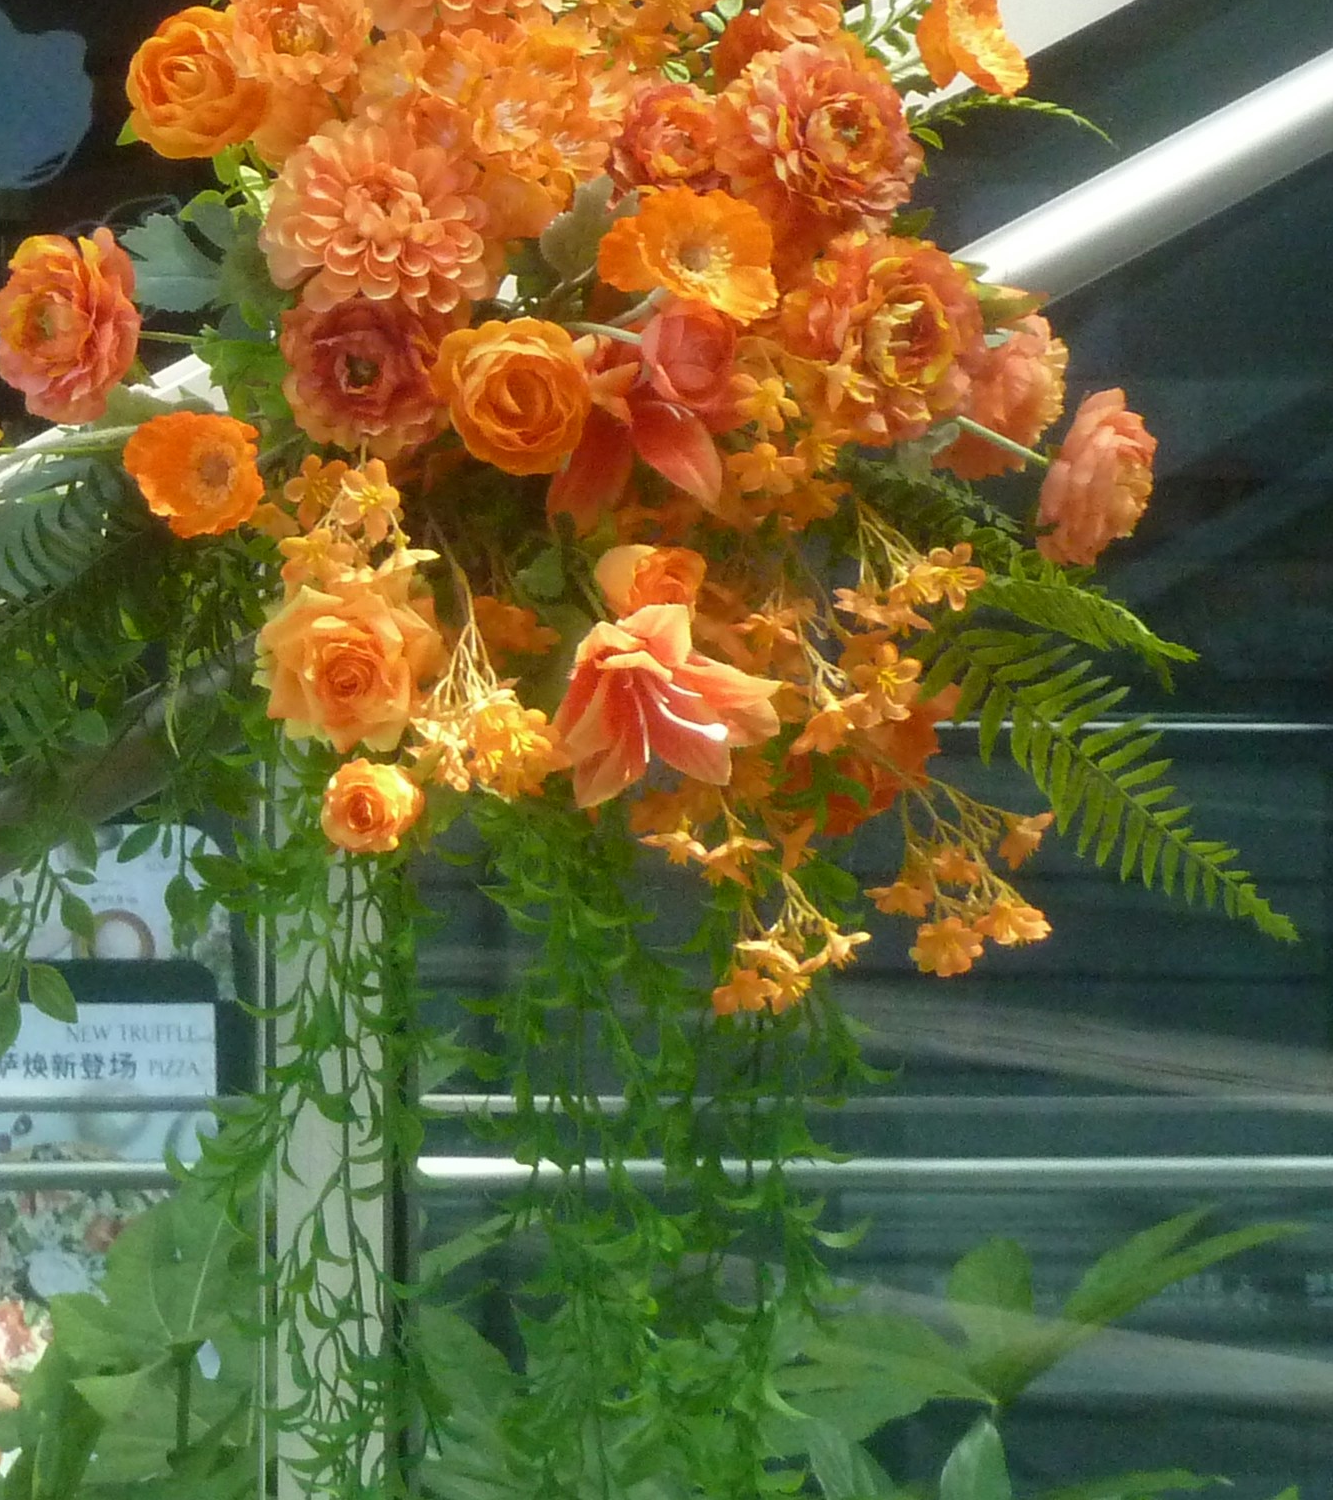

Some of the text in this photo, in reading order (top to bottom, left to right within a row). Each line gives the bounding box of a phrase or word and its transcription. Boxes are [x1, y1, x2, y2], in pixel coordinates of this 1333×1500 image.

[66, 1023, 196, 1043] NEW TRUFFLE
[148, 1058, 201, 1077] PIZZA
